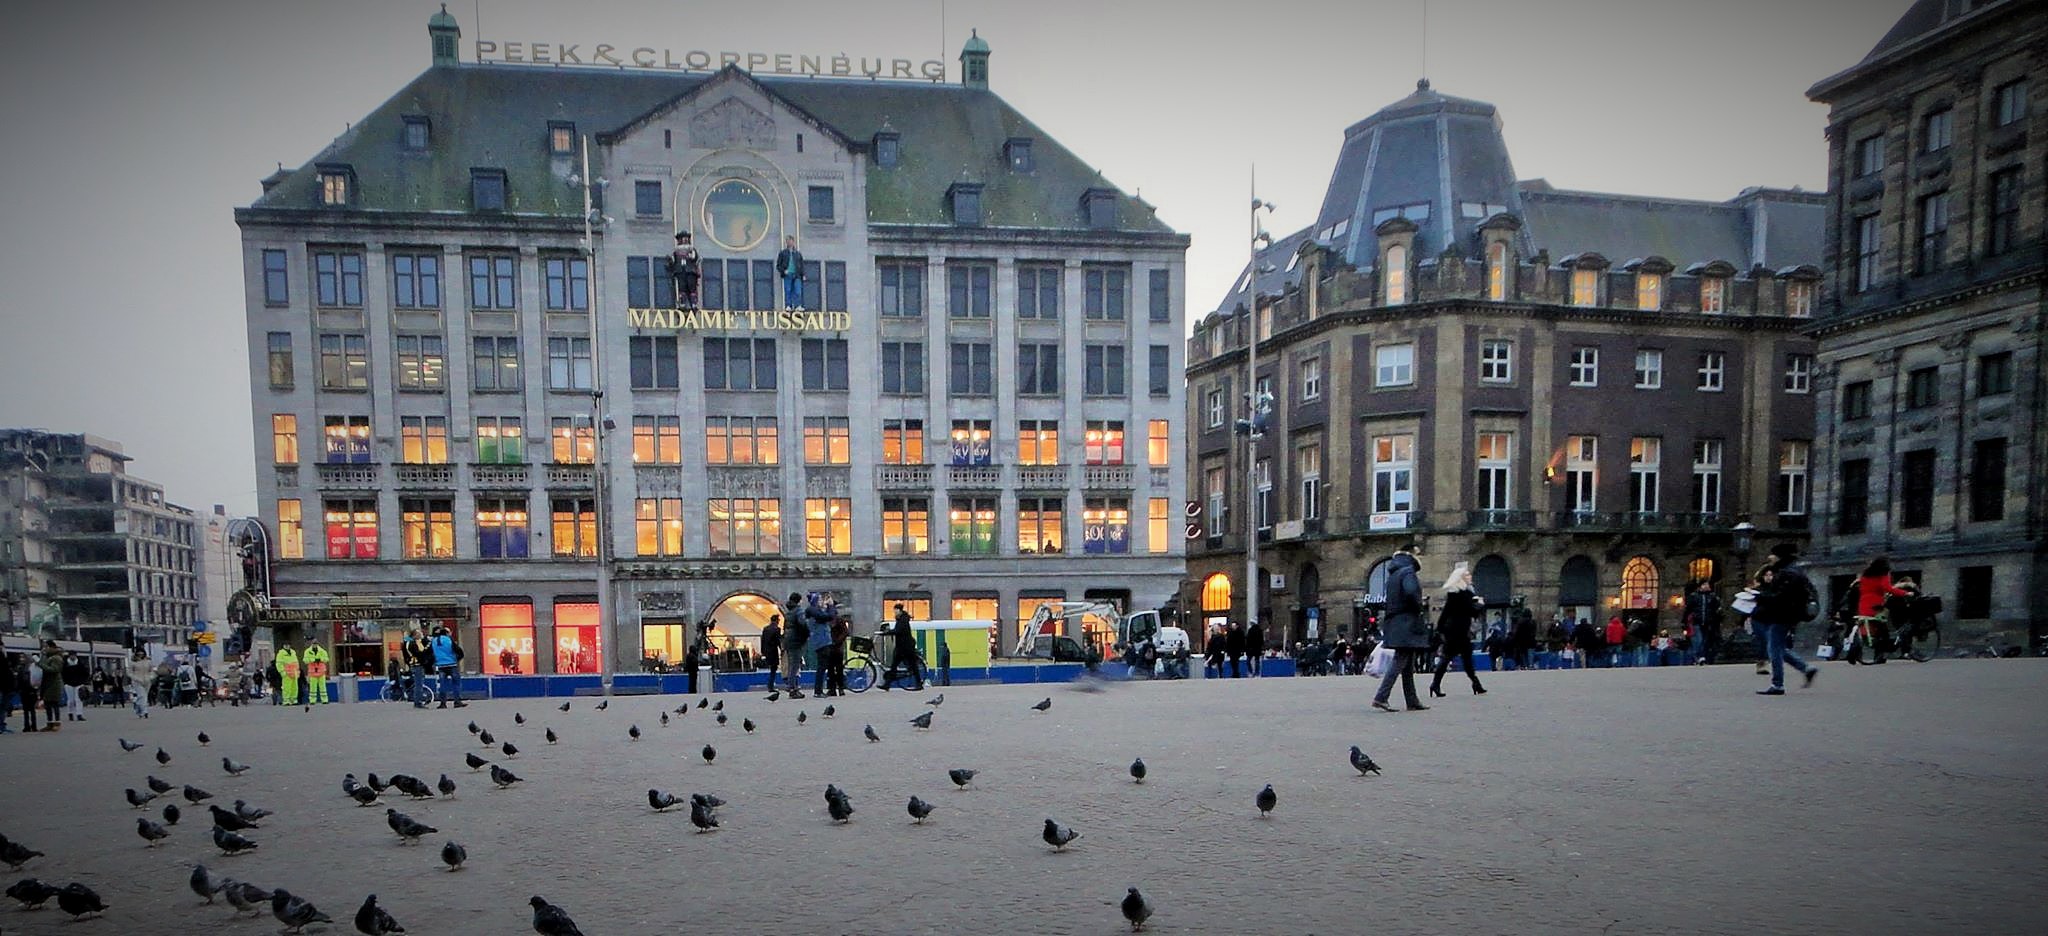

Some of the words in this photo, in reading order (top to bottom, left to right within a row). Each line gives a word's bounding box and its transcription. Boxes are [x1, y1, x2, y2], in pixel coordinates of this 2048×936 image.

[628, 308, 738, 329] MADAME
[745, 310, 851, 331] TUSSAUD
[266, 608, 321, 620] MADAME
[487, 637, 534, 655] SALE
